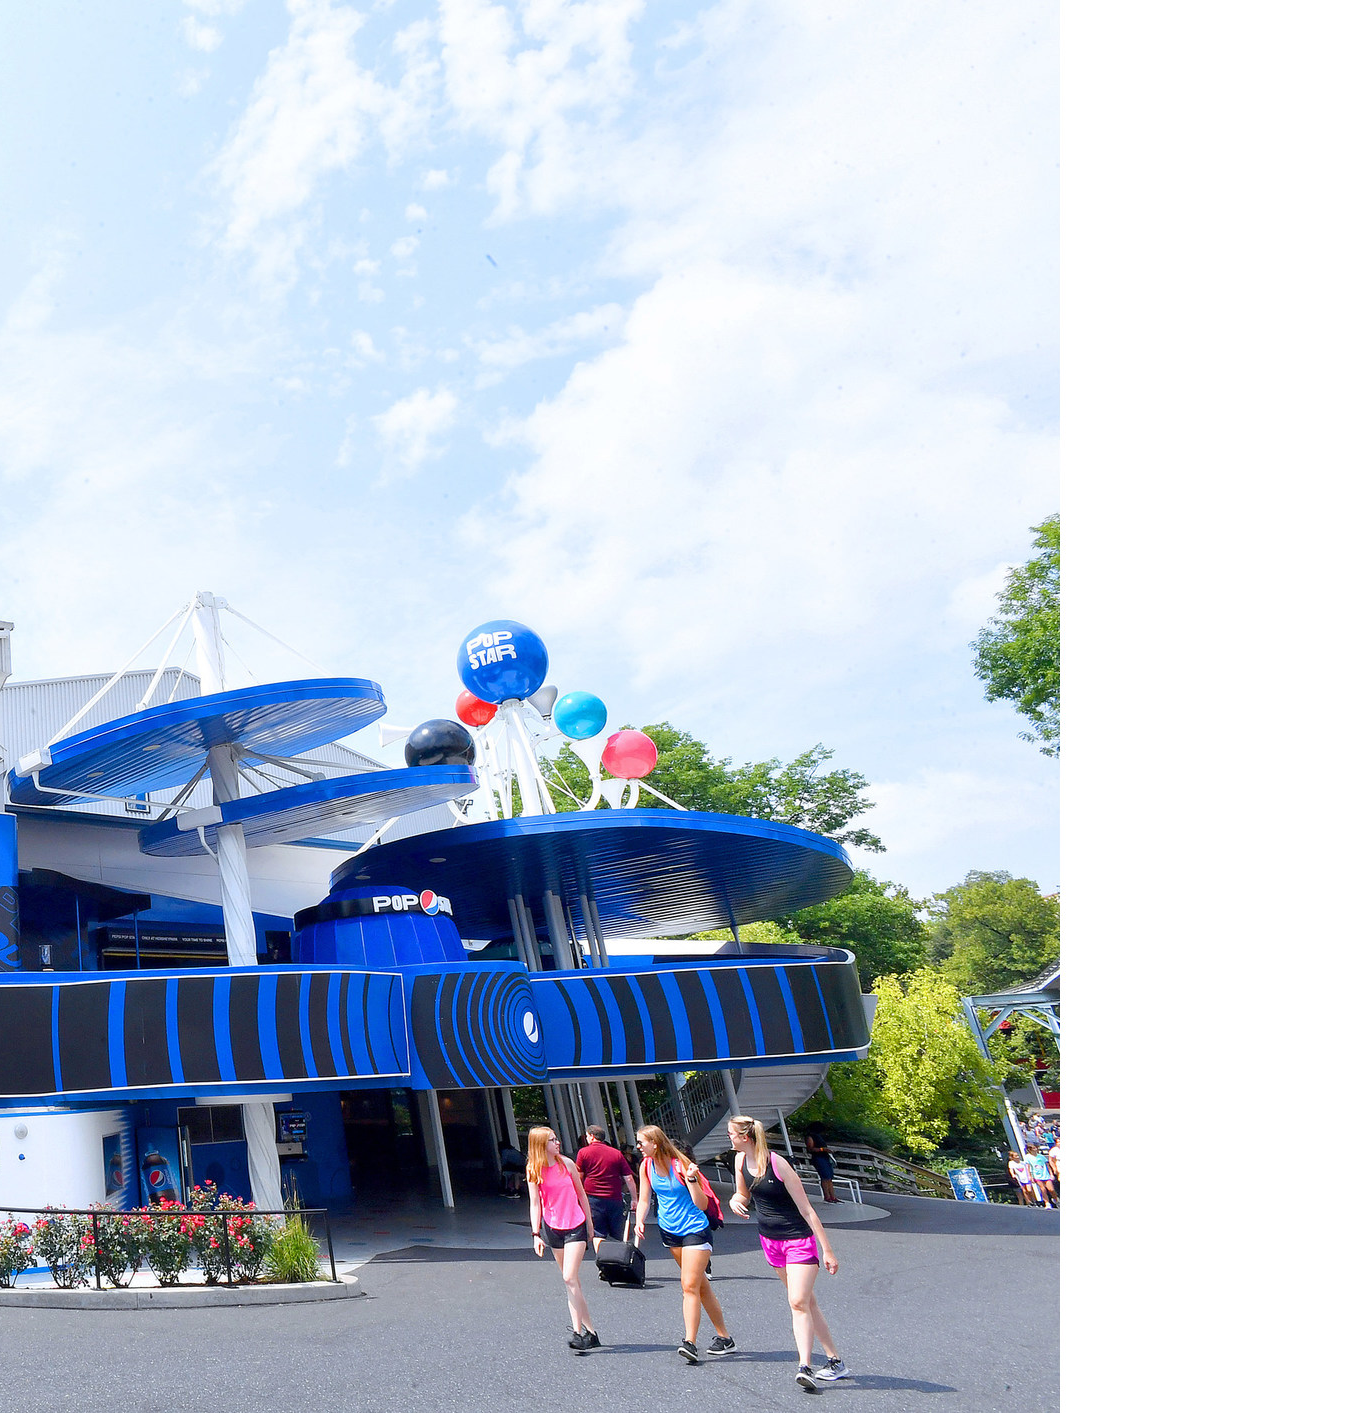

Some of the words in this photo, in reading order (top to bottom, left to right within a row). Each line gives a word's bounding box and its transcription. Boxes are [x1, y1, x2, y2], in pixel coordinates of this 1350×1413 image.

[466, 631, 513, 655] POP
[468, 644, 517, 670] STAR
[372, 894, 419, 913] POP
